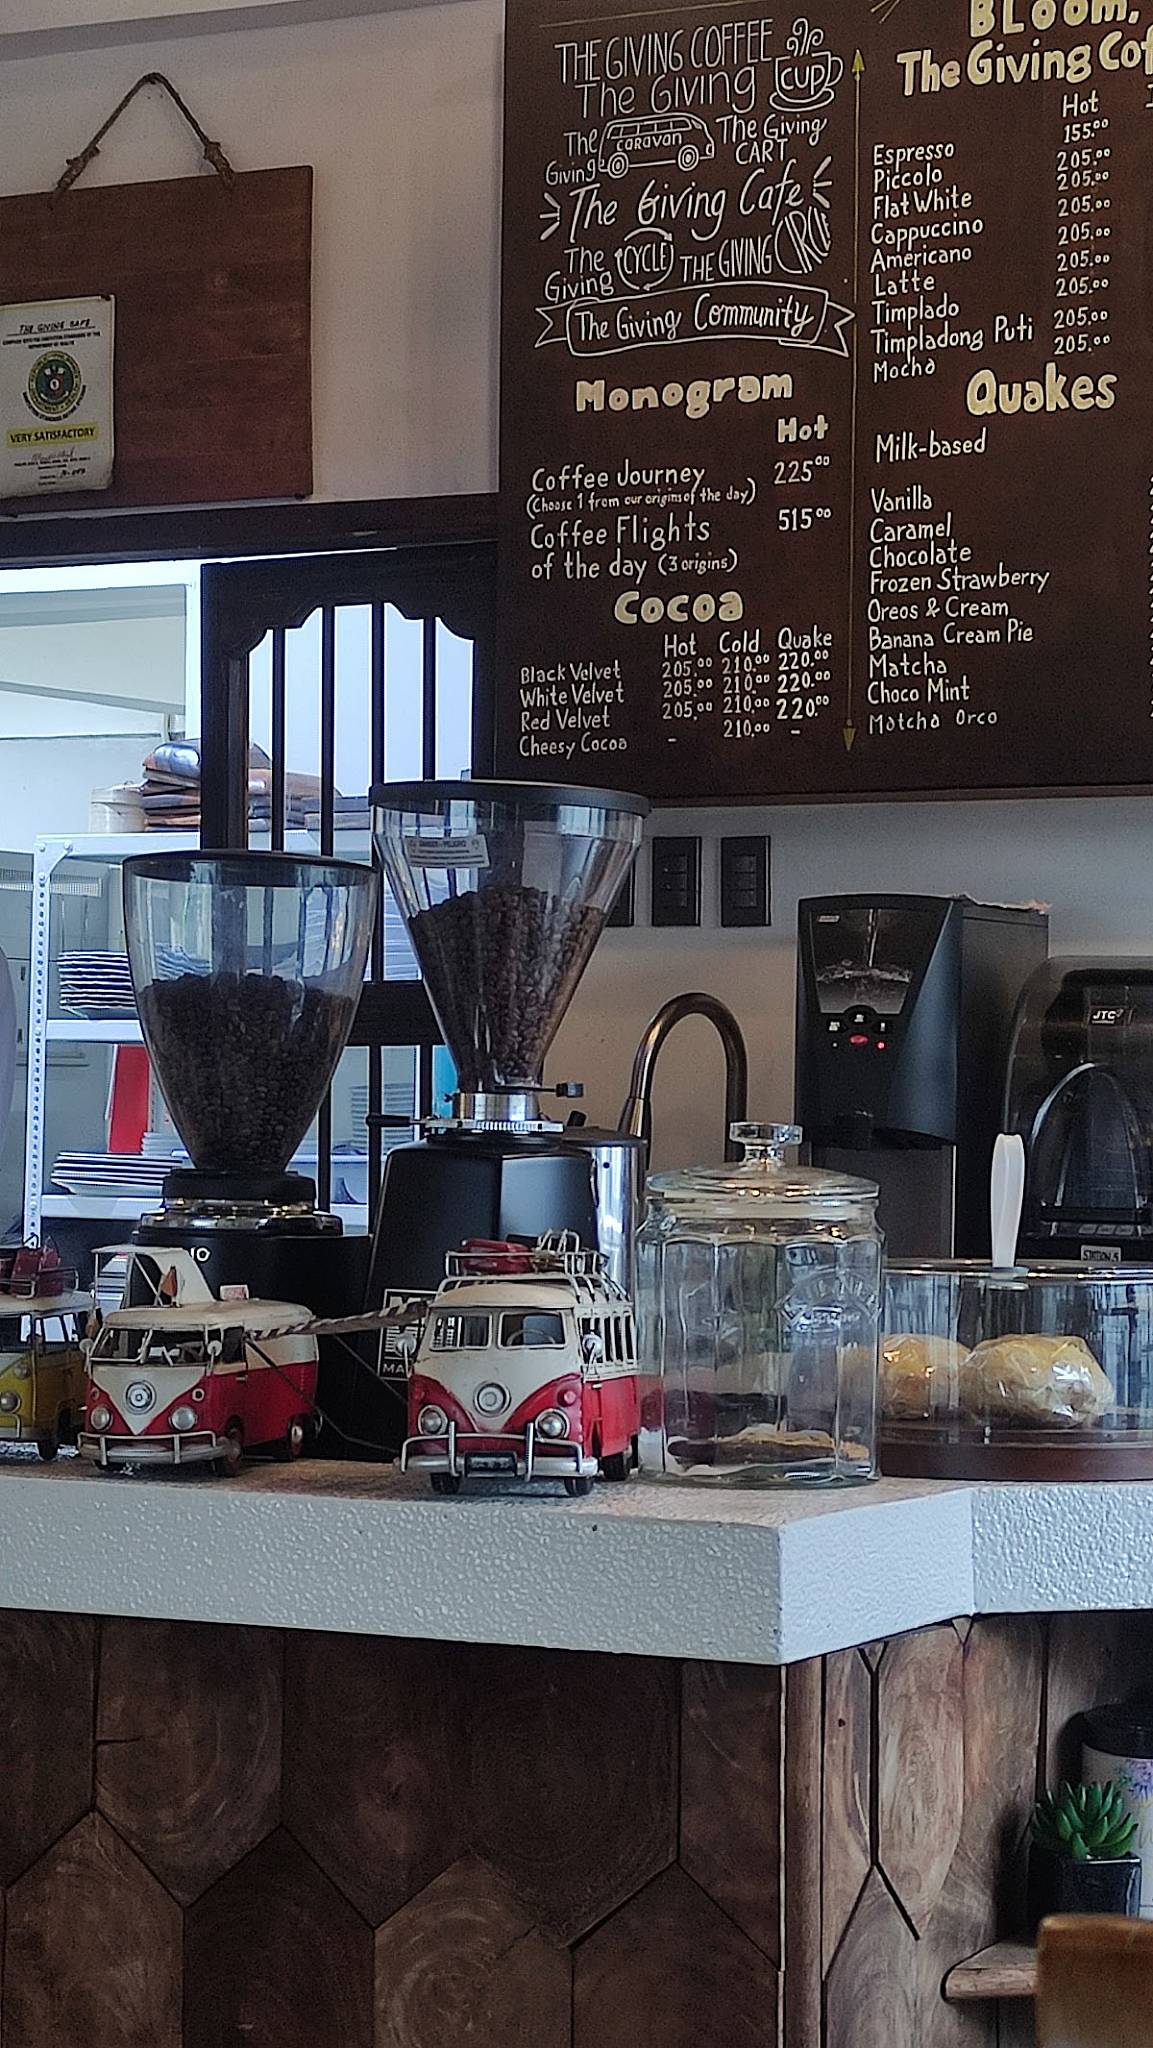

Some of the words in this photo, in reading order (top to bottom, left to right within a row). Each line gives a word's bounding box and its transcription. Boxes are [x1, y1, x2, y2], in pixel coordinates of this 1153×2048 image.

[555, 40, 602, 84] THE
[605, 29, 684, 80] GIVING
[691, 19, 773, 68] COFFEE
[897, 49, 961, 97] The
[967, 39, 1092, 85] Giving
[575, 82, 636, 118] The
[651, 65, 756, 114] Giving
[1061, 90, 1099, 117] Hot
[564, 129, 598, 157] The
[715, 115, 757, 143] The
[763, 113, 827, 145] Giving
[735, 139, 788, 165] CART
[873, 142, 955, 172] Espresso
[546, 160, 596, 185] Giving
[874, 162, 943, 193] Piccolo
[569, 183, 618, 243] The
[638, 179, 726, 241] Giving
[739, 158, 804, 226] Cafe
[874, 193, 910, 220] Flat
[913, 185, 973, 214] White
[871, 213, 984, 251] Cappuccino
[564, 247, 604, 273] The
[623, 242, 669, 275] CYCLE
[680, 252, 715, 282] THE
[718, 234, 773, 277] GIVING
[870, 245, 972, 273] Americano
[545, 271, 614, 303] Giving
[875, 270, 935, 297] Latte
[575, 310, 610, 341] The
[617, 306, 682, 340] Giving
[694, 293, 814, 337] Community
[872, 293, 960, 331] Timplado
[870, 321, 984, 363] Timpladong
[994, 314, 1033, 343] Puti
[874, 358, 935, 383] Mocha
[576, 373, 793, 419] Monogram
[967, 362, 1118, 415] Quakes
[10, 433, 32, 444] VERY
[34, 427, 95, 442] SATISFACTORY
[777, 415, 828, 443] Hot
[876, 427, 987, 463] Milk-based
[532, 465, 609, 492] Coffee
[617, 459, 705, 493] Journey
[526, 494, 572, 519] (Choose
[577, 494, 584, 510] 1
[588, 492, 619, 512] from
[624, 495, 642, 506] our
[645, 489, 682, 507] origins
[699, 487, 721, 503] the
[725, 478, 756, 505] day)
[871, 485, 933, 513] Vanilla
[531, 521, 608, 549] Coffee
[617, 511, 710, 551] Flights
[870, 512, 951, 544] Caramel
[531, 553, 555, 579] of
[564, 551, 600, 579] the
[609, 548, 647, 585] day
[682, 548, 738, 575] origins)
[869, 539, 972, 568] Chocolate
[870, 571, 931, 595] Frozen
[937, 562, 1050, 594] Strawberry
[614, 590, 743, 624] Cocoa
[868, 599, 919, 622] Oreos
[945, 596, 1009, 618] Cream
[664, 633, 697, 657] Hot
[719, 629, 760, 653] Cold
[778, 625, 832, 650] Quake
[869, 626, 934, 651] Banana
[944, 622, 1001, 644] Cream
[1008, 618, 1034, 643] Pie
[521, 663, 566, 685] Black
[570, 660, 621, 681] Velvet
[869, 652, 948, 679] Matcha
[520, 685, 568, 708] White
[571, 681, 624, 704] Velvet
[868, 682, 919, 704] Choco
[928, 675, 970, 702] Mint
[521, 709, 550, 732] Red
[556, 705, 610, 730] Velvet
[520, 736, 576, 760] Cheesy
[580, 733, 627, 753] Cocoa
[1092, 1010, 1117, 1020] JTC
